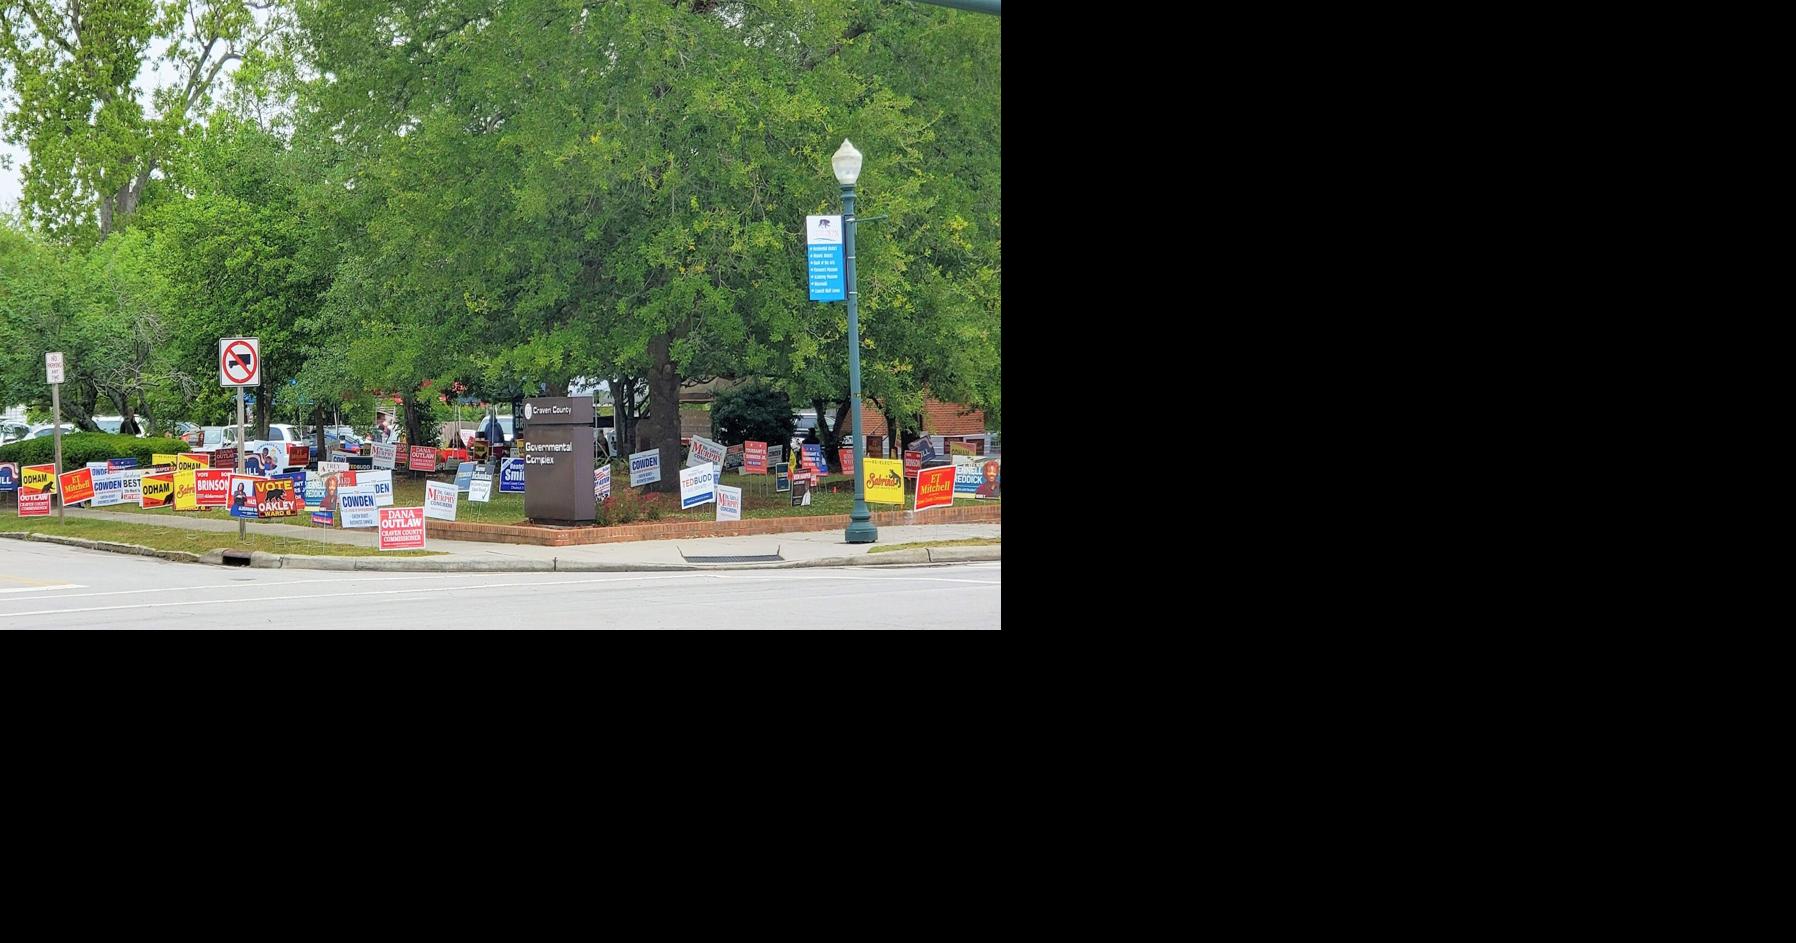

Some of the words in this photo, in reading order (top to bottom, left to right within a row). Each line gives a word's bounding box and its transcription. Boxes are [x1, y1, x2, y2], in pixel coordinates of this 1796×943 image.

[552, 406, 572, 415] County
[525, 442, 573, 452] Governmental
[692, 441, 721, 462] MURPHY
[178, 462, 201, 470] ODHAM
[525, 454, 554, 466] Complex
[631, 456, 658, 471] COWDEN
[23, 474, 48, 484] ODHAM
[94, 480, 122, 491] COWDEN
[143, 483, 170, 495] ODHAM
[255, 480, 293, 492] VOTE
[921, 480, 950, 494] Mitchell
[342, 495, 374, 508] COWDEN
[427, 487, 455, 504] MURPHY
[258, 500, 295, 512] OAKLEY
[388, 510, 415, 519] DANA
[381, 519, 422, 529] OUTLAW
